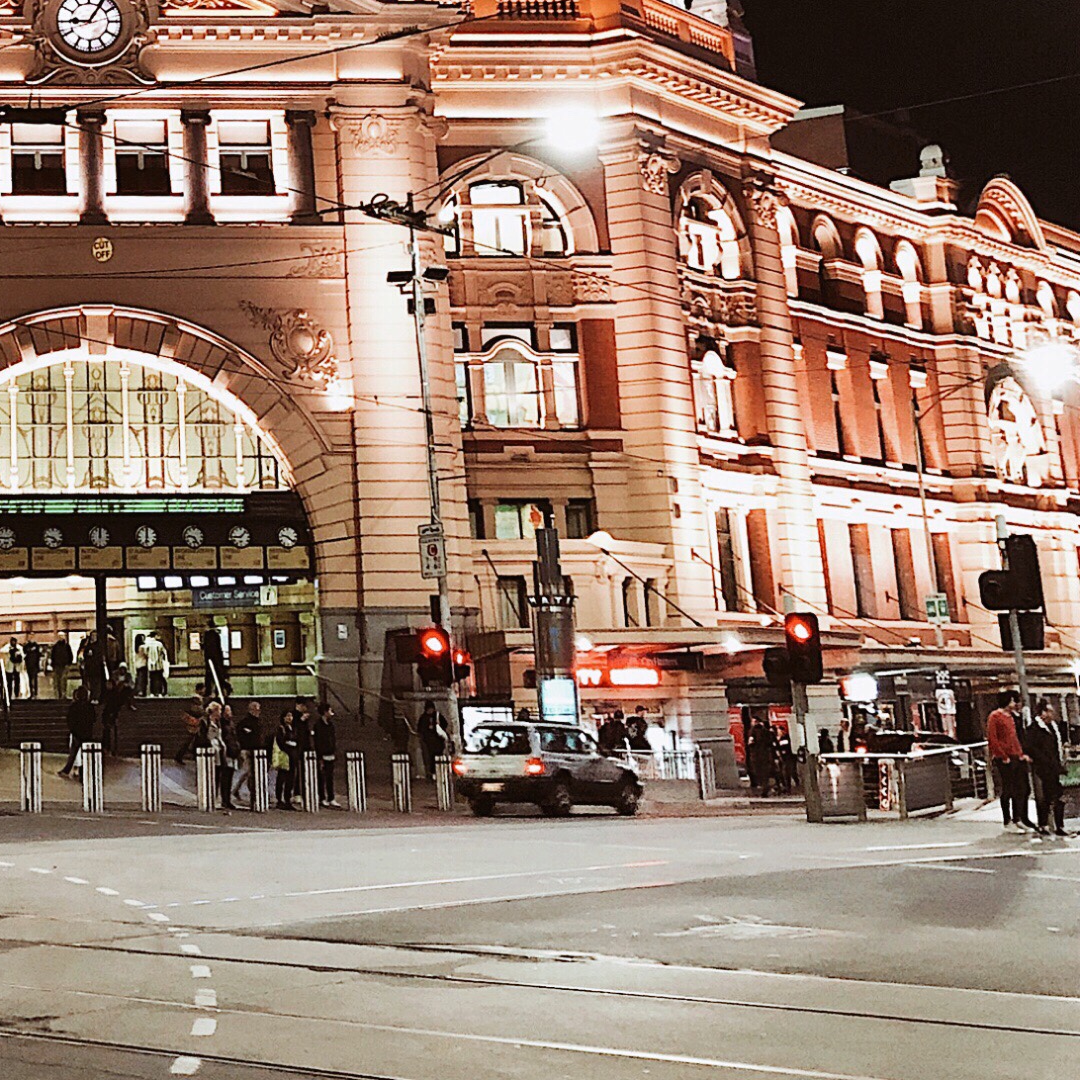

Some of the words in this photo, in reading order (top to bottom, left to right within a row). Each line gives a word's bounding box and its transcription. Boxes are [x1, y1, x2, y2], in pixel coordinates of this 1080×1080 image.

[94, 241, 108, 249] CUT
[96, 251, 110, 259] OFF
[200, 591, 232, 600] Customer
[234, 589, 259, 599] Service
